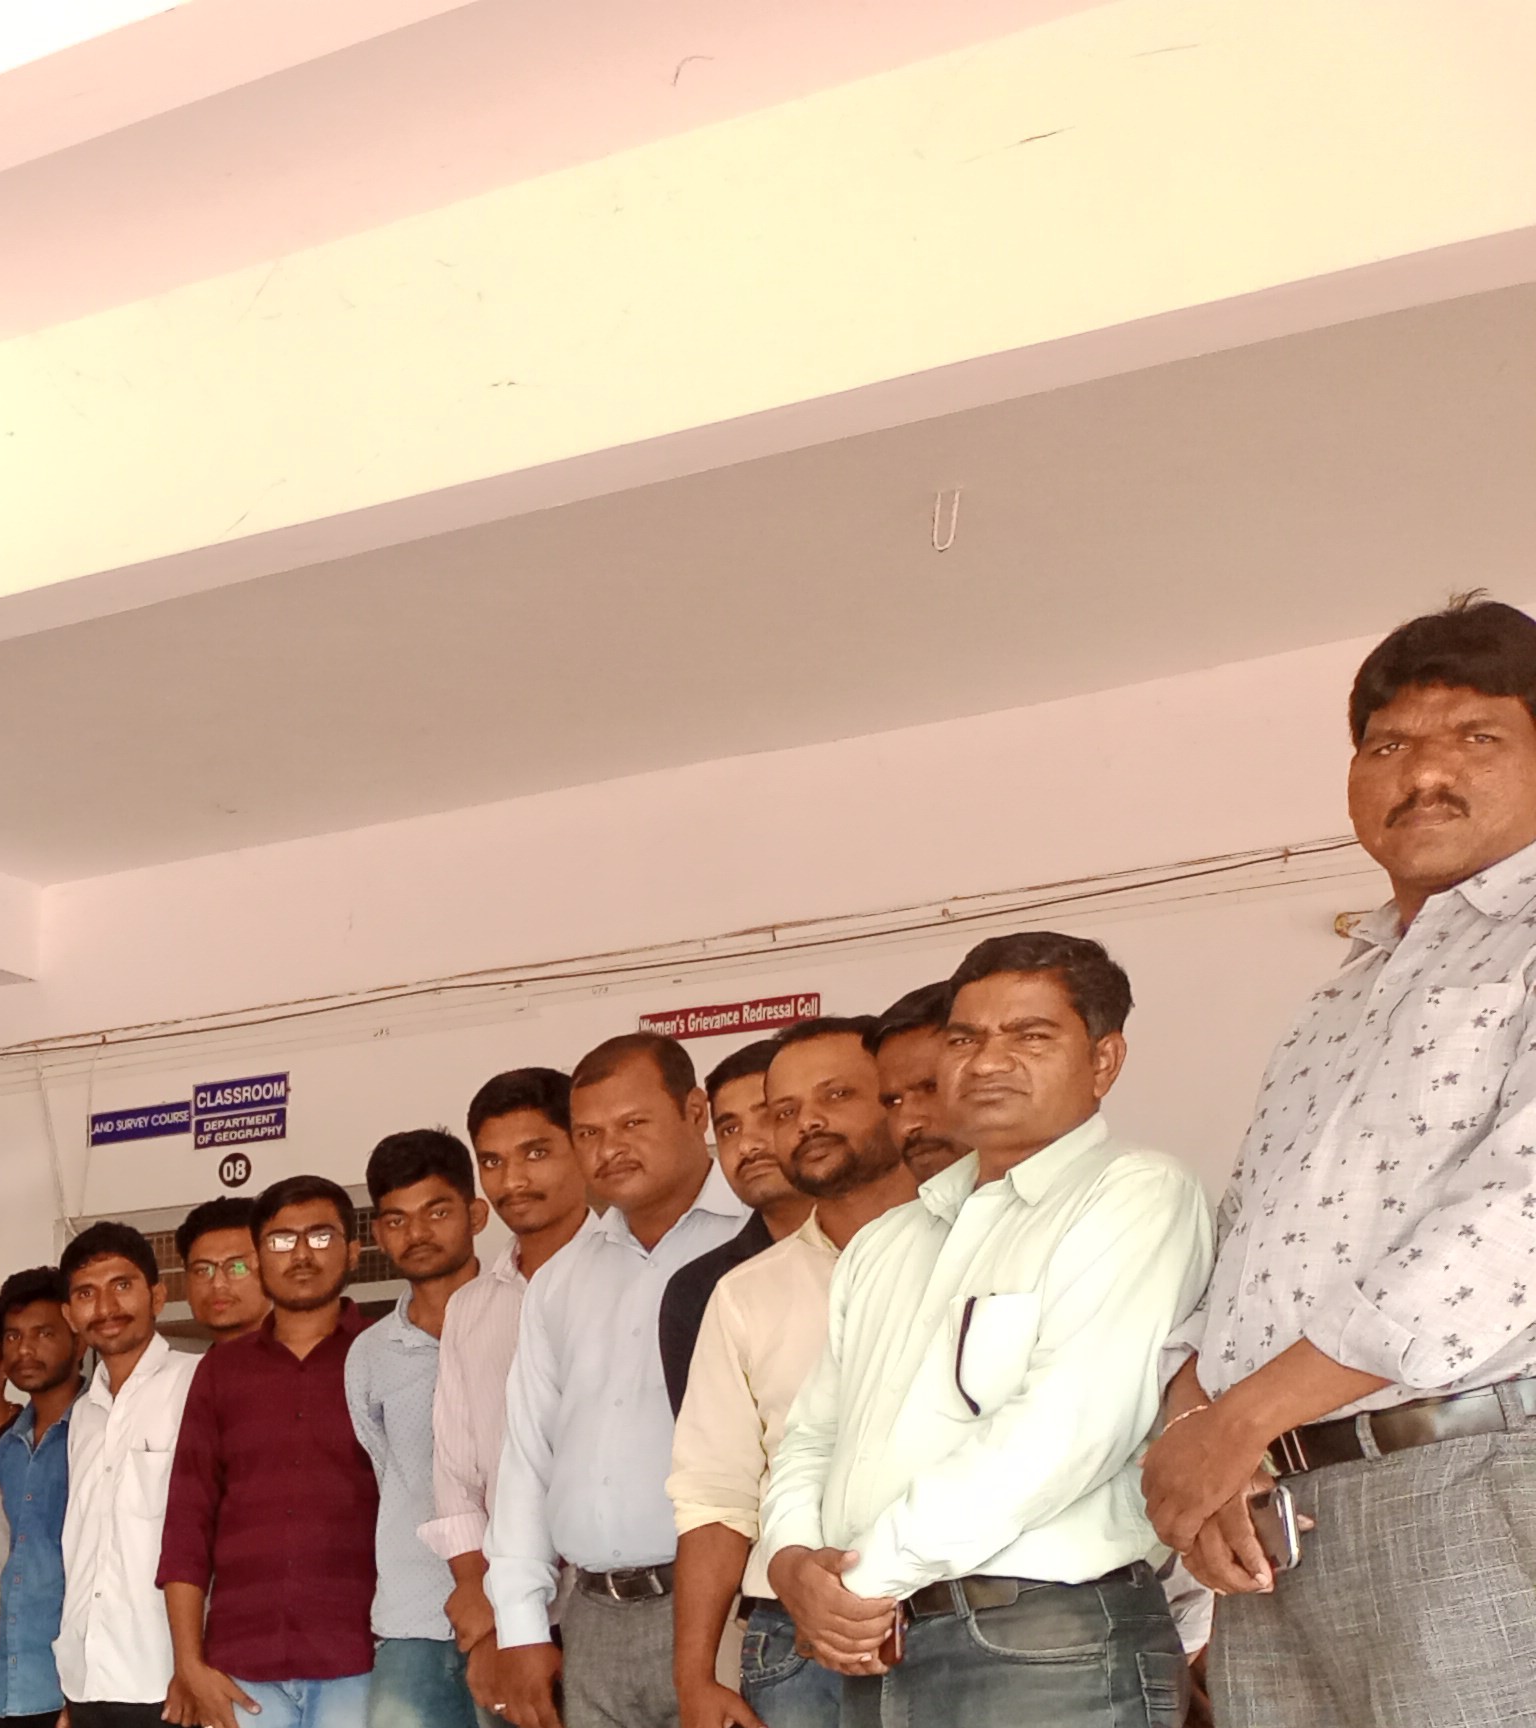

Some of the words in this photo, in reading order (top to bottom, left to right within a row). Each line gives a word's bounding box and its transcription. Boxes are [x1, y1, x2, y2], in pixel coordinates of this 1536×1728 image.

[639, 1014, 686, 1035] Women's
[688, 1009, 739, 1033] Grievance
[742, 1001, 795, 1024] Redressal
[797, 996, 819, 1017] Cell
[196, 1081, 286, 1108] CLASSROOM
[116, 1113, 149, 1131] SURVEY
[150, 1110, 189, 1127] COURSE
[203, 1113, 277, 1131] DEPARTMENT
[197, 1131, 212, 1145] OF
[214, 1125, 283, 1143] GEOGRAPHY
[222, 1160, 246, 1181] 08
